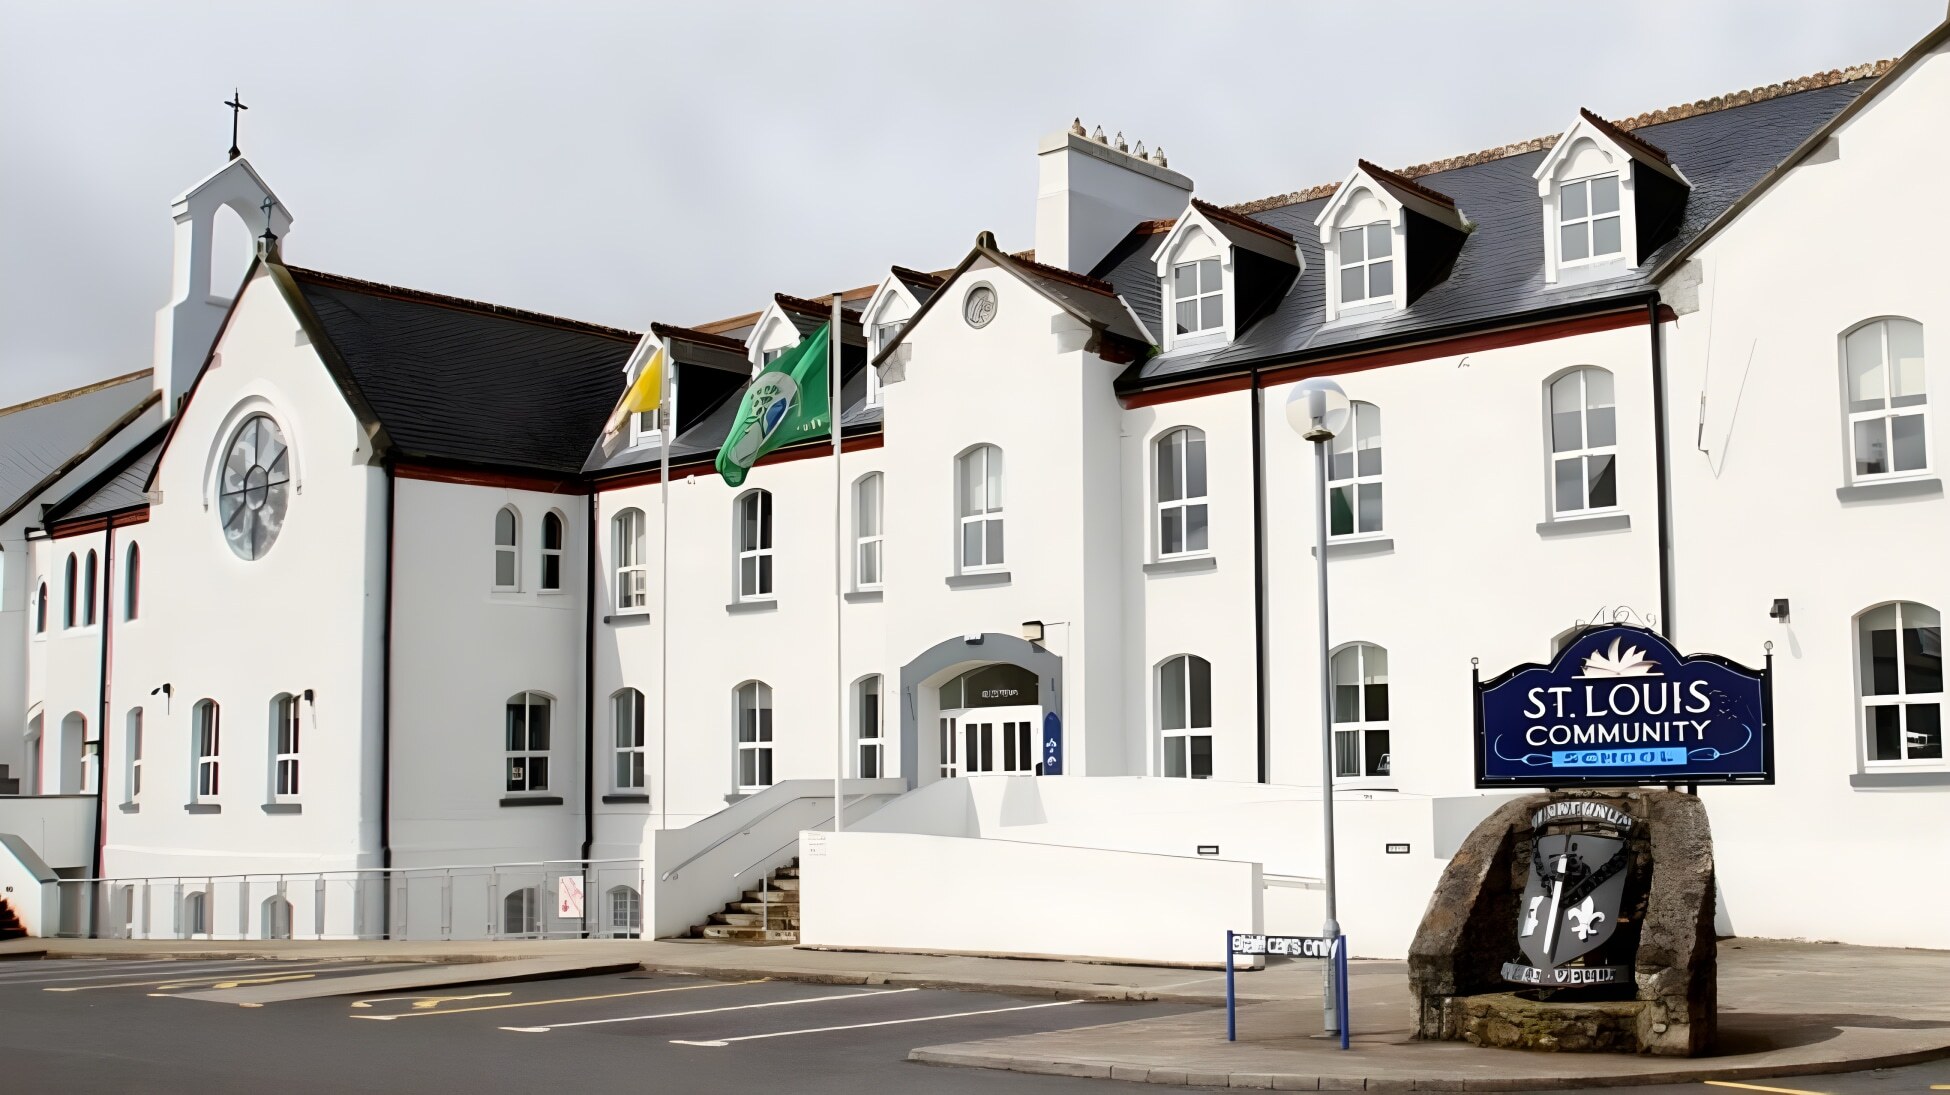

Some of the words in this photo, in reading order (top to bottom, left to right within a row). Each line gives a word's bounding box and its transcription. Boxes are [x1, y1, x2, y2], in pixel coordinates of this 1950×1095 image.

[1523, 687, 1576, 719] ST.
[1585, 680, 1711, 718] LOUIS
[1525, 720, 1711, 746] COMMUNITY
